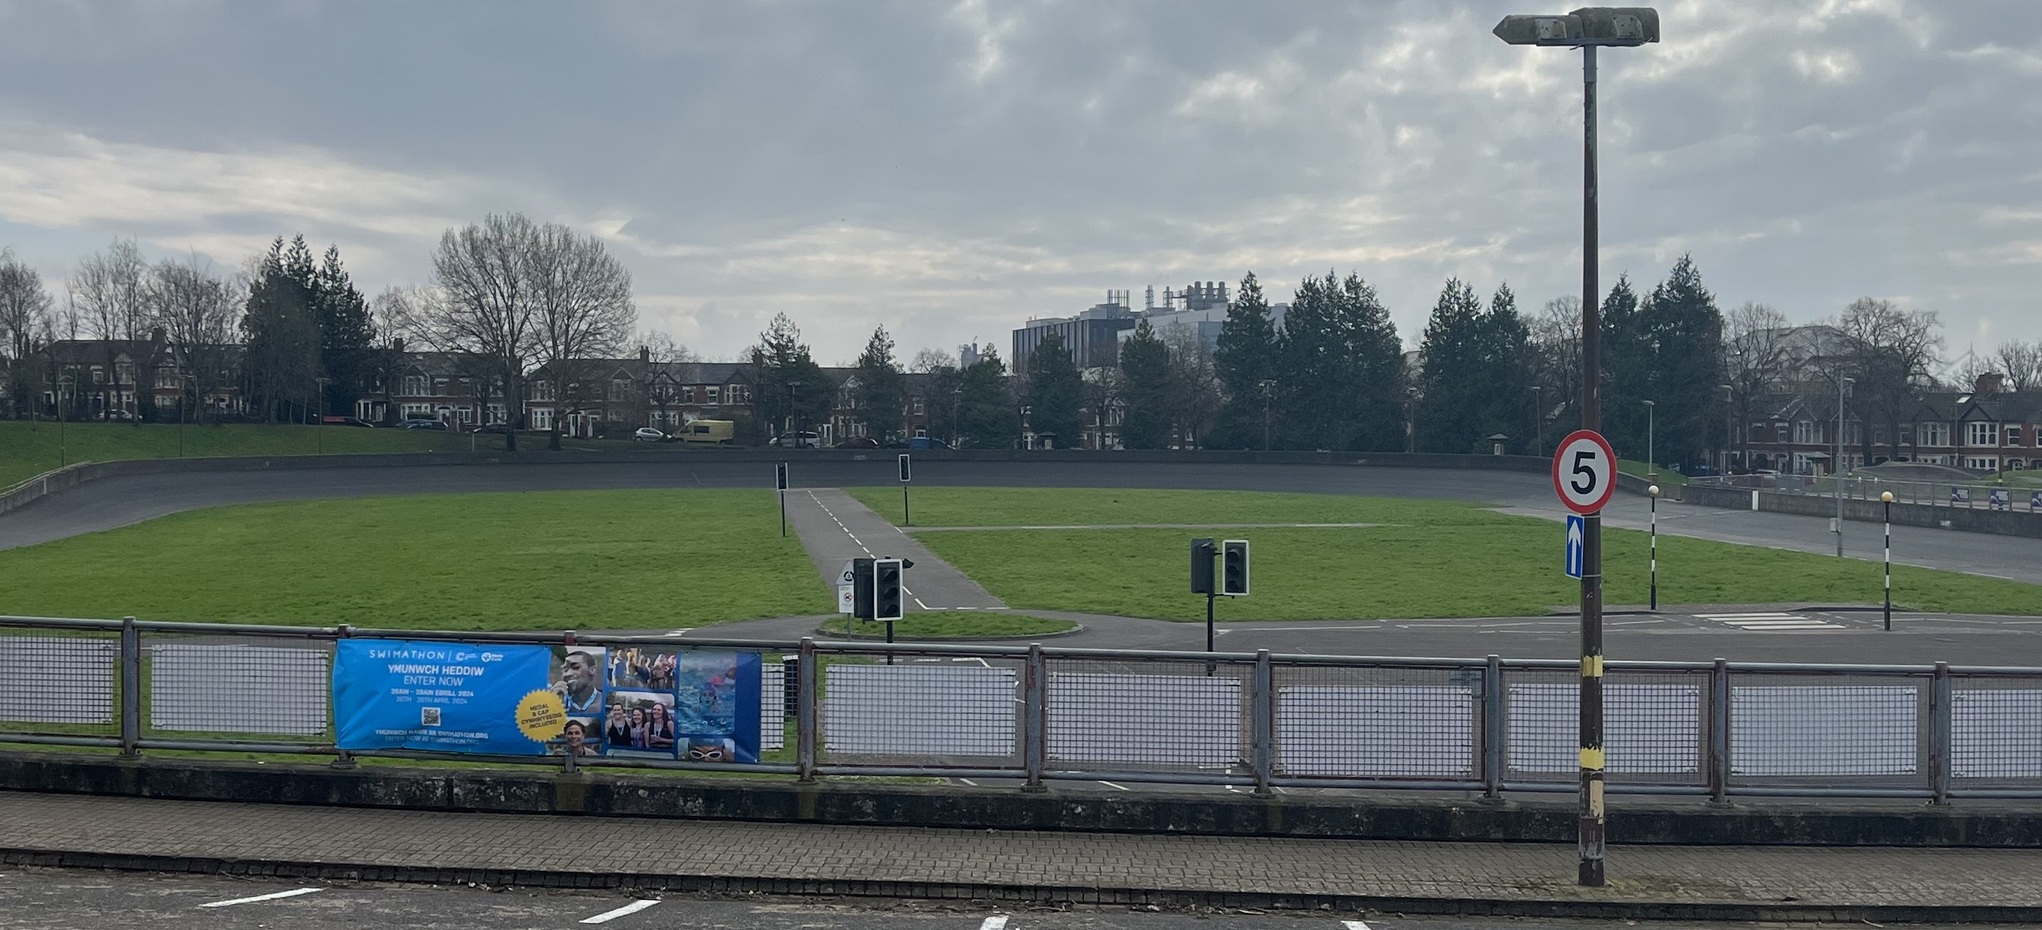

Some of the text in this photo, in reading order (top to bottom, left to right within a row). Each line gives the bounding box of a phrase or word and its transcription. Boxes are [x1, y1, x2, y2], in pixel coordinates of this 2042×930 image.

[1571, 451, 1596, 494] 5
[369, 650, 445, 660] SWIMATHON
[388, 664, 484, 676] YMUNWCH HEDDIW
[404, 676, 464, 686] ENTER NOW
[529, 719, 557, 728] INCLUDED
